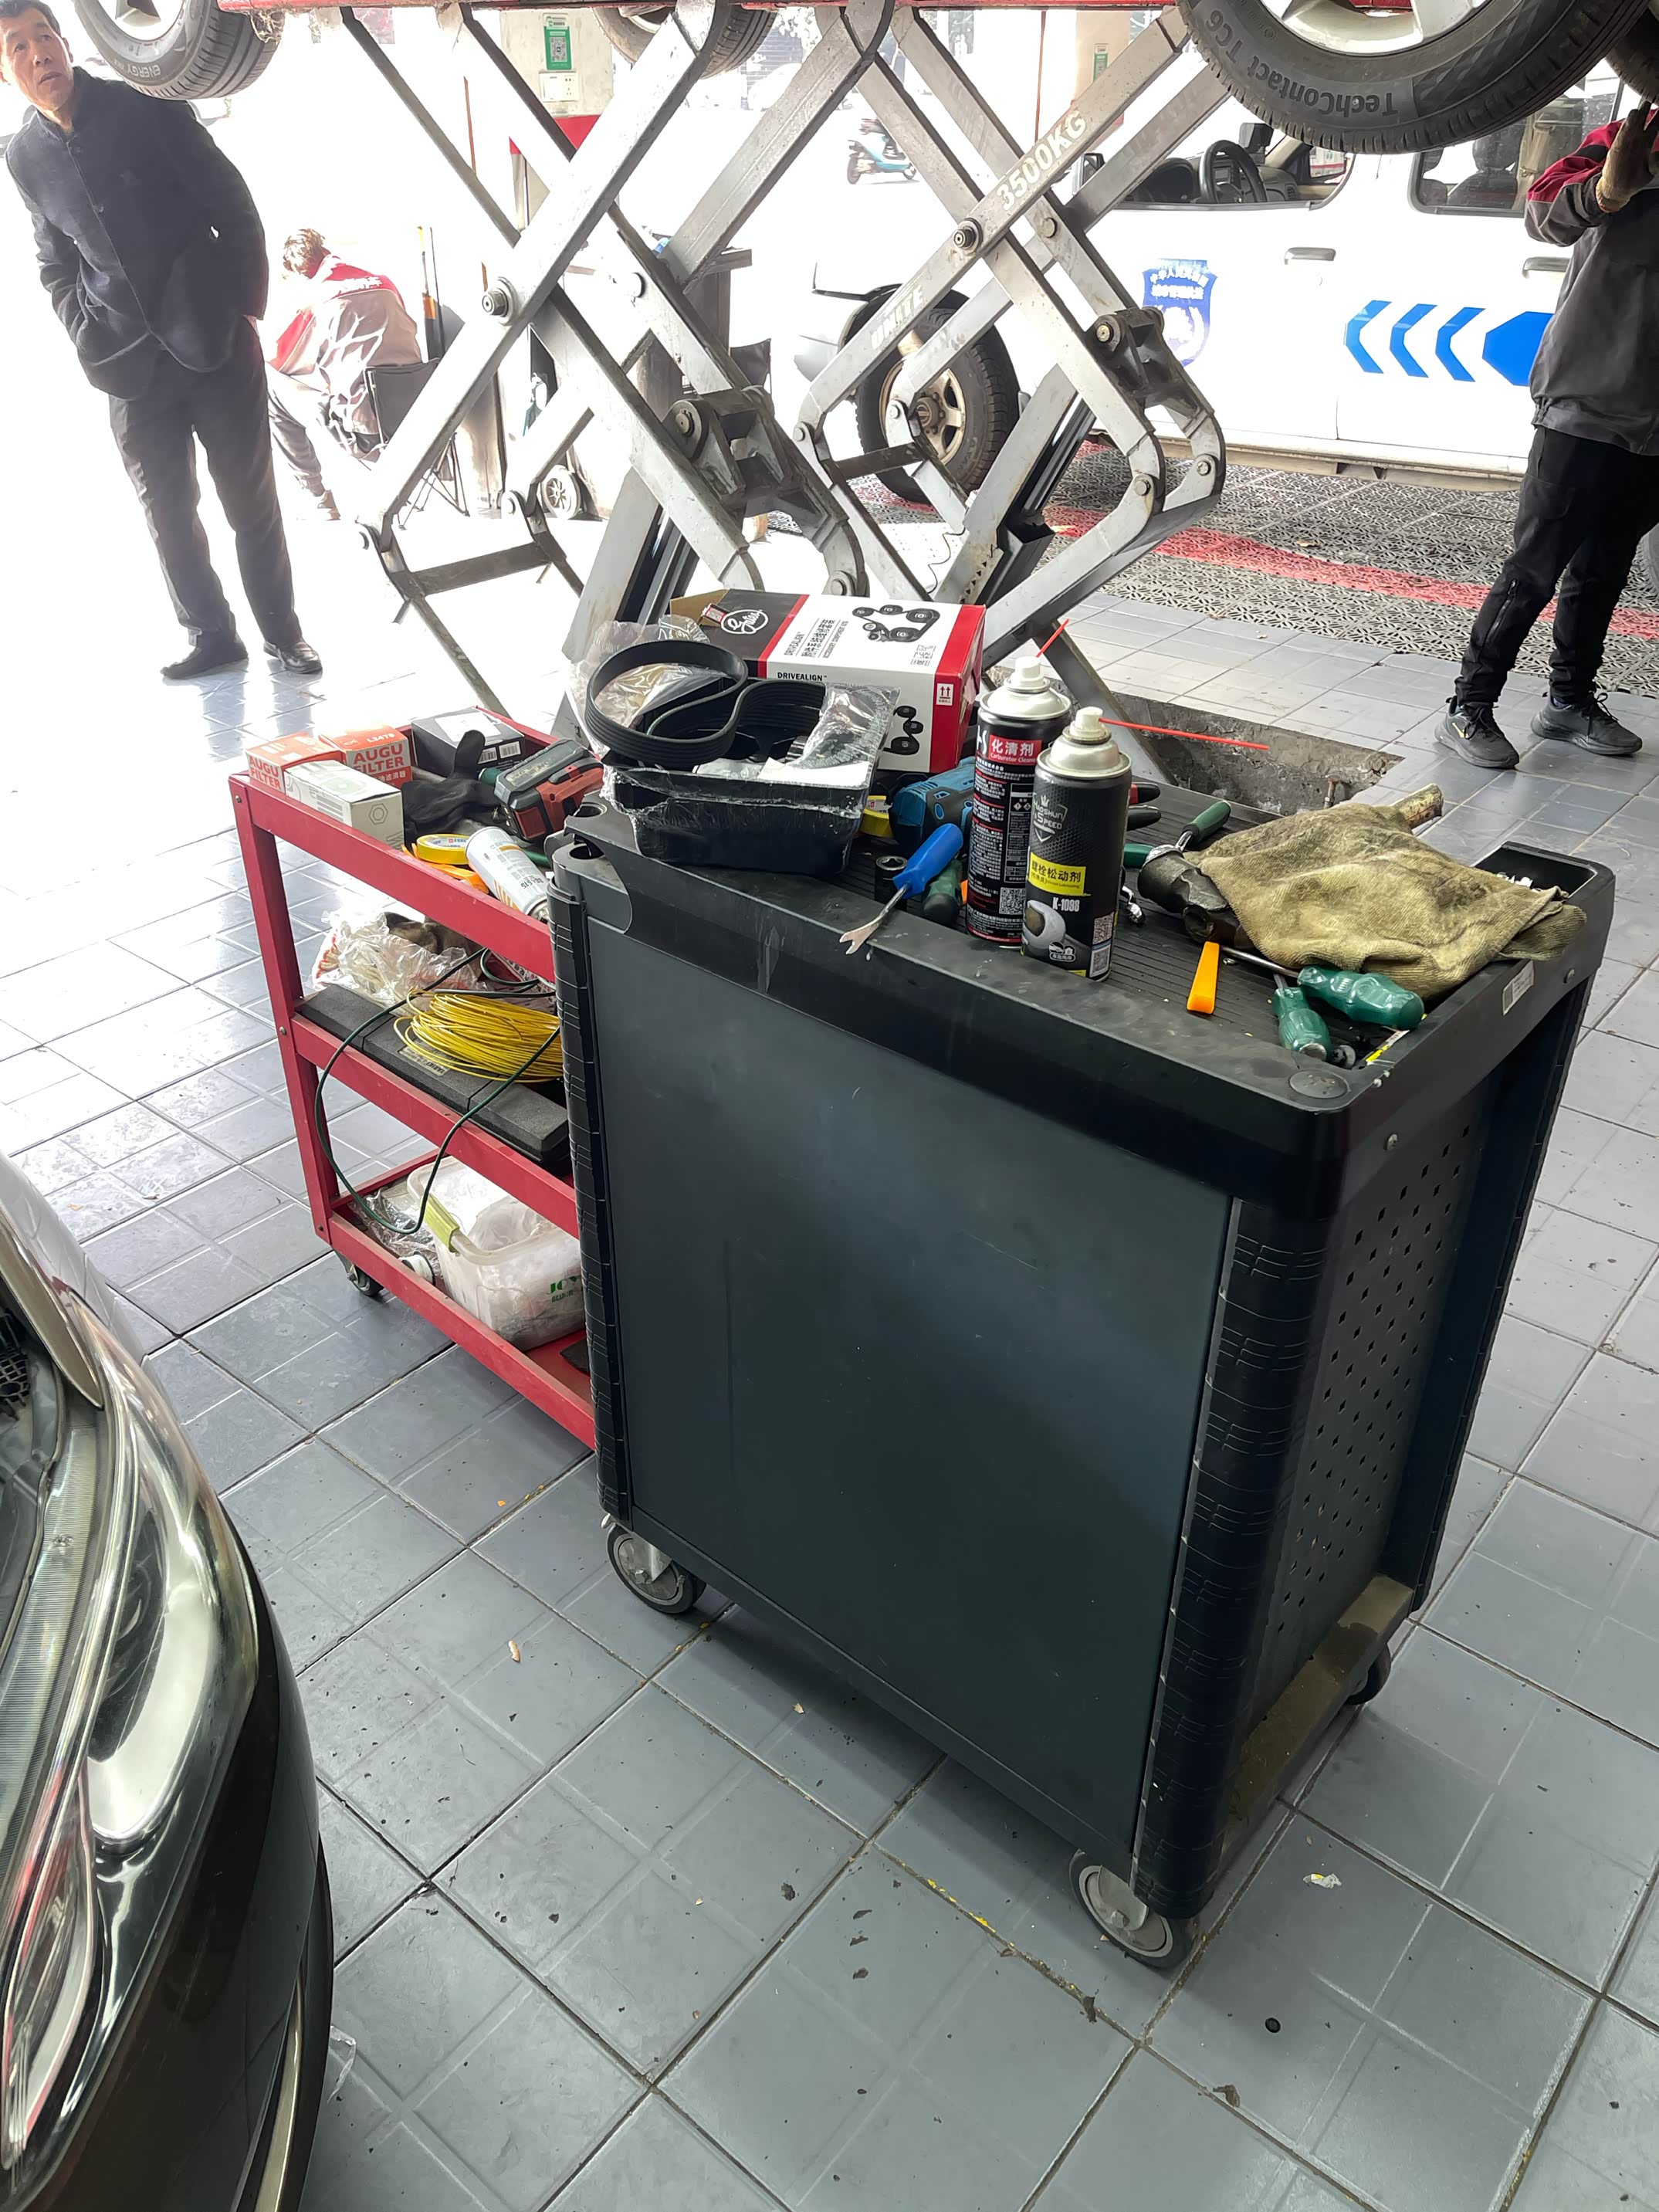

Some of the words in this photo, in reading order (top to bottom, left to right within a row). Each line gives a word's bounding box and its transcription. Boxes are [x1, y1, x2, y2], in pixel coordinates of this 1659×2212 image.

[1206, 9, 1244, 64] TC6
[127, 64, 161, 78] ENERGY
[1247, 55, 1399, 118] TechContact
[997, 110, 1087, 211] 3500KG
[777, 672, 823, 682] DRIVEALIGN
[354, 744, 403, 764] AUGU
[991, 738, 1034, 757] 化清剂
[248, 756, 279, 777] AUGU
[250, 767, 282, 791] FILTER
